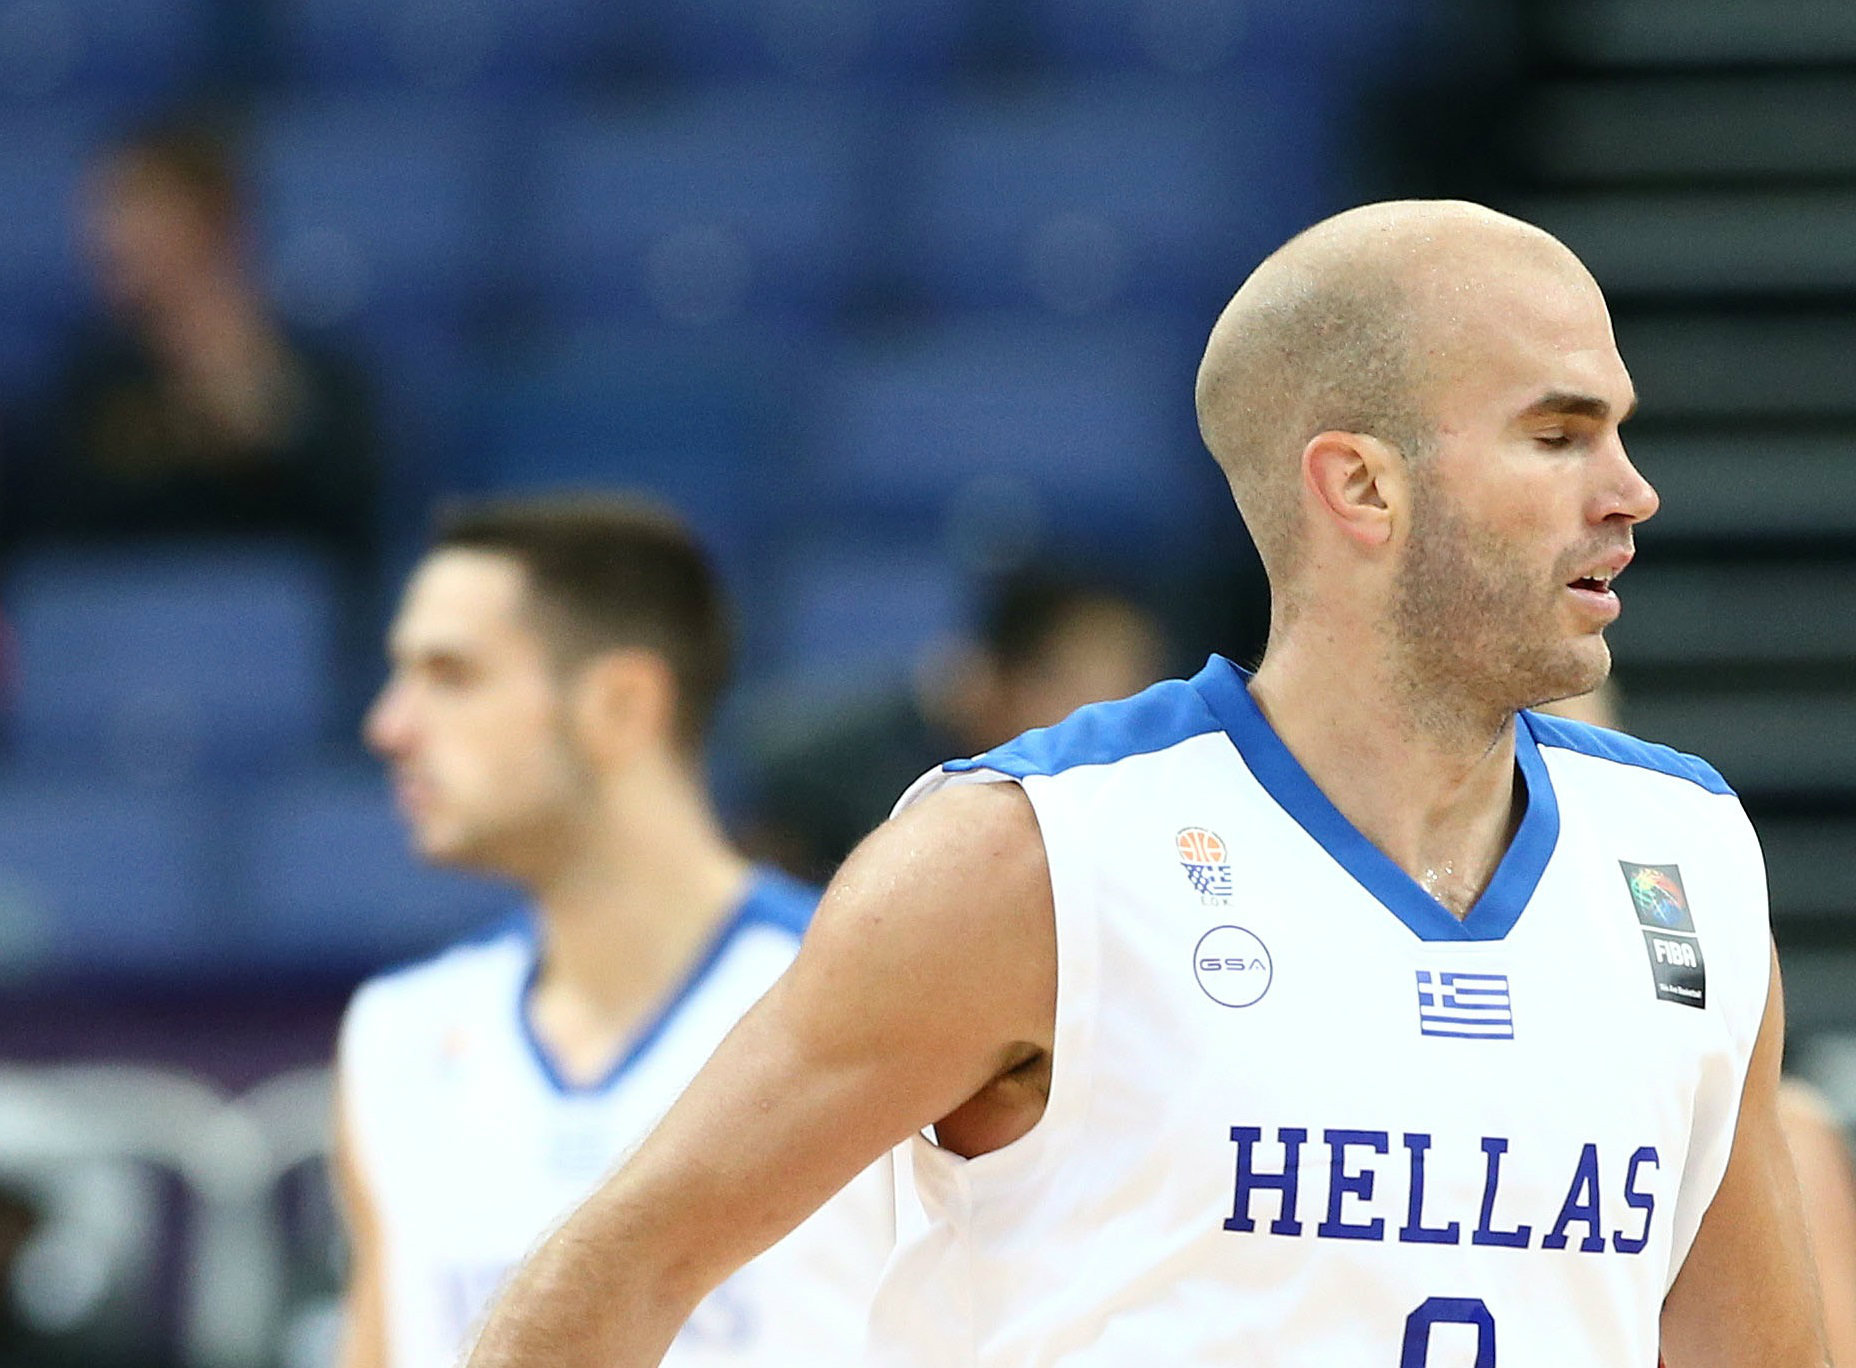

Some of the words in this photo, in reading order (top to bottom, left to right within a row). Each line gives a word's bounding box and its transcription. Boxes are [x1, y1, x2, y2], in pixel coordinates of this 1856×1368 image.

[1200, 958, 1266, 971] GSA
[1653, 938, 1697, 968] FIBA
[1223, 1126, 1660, 1255] HELLAS
